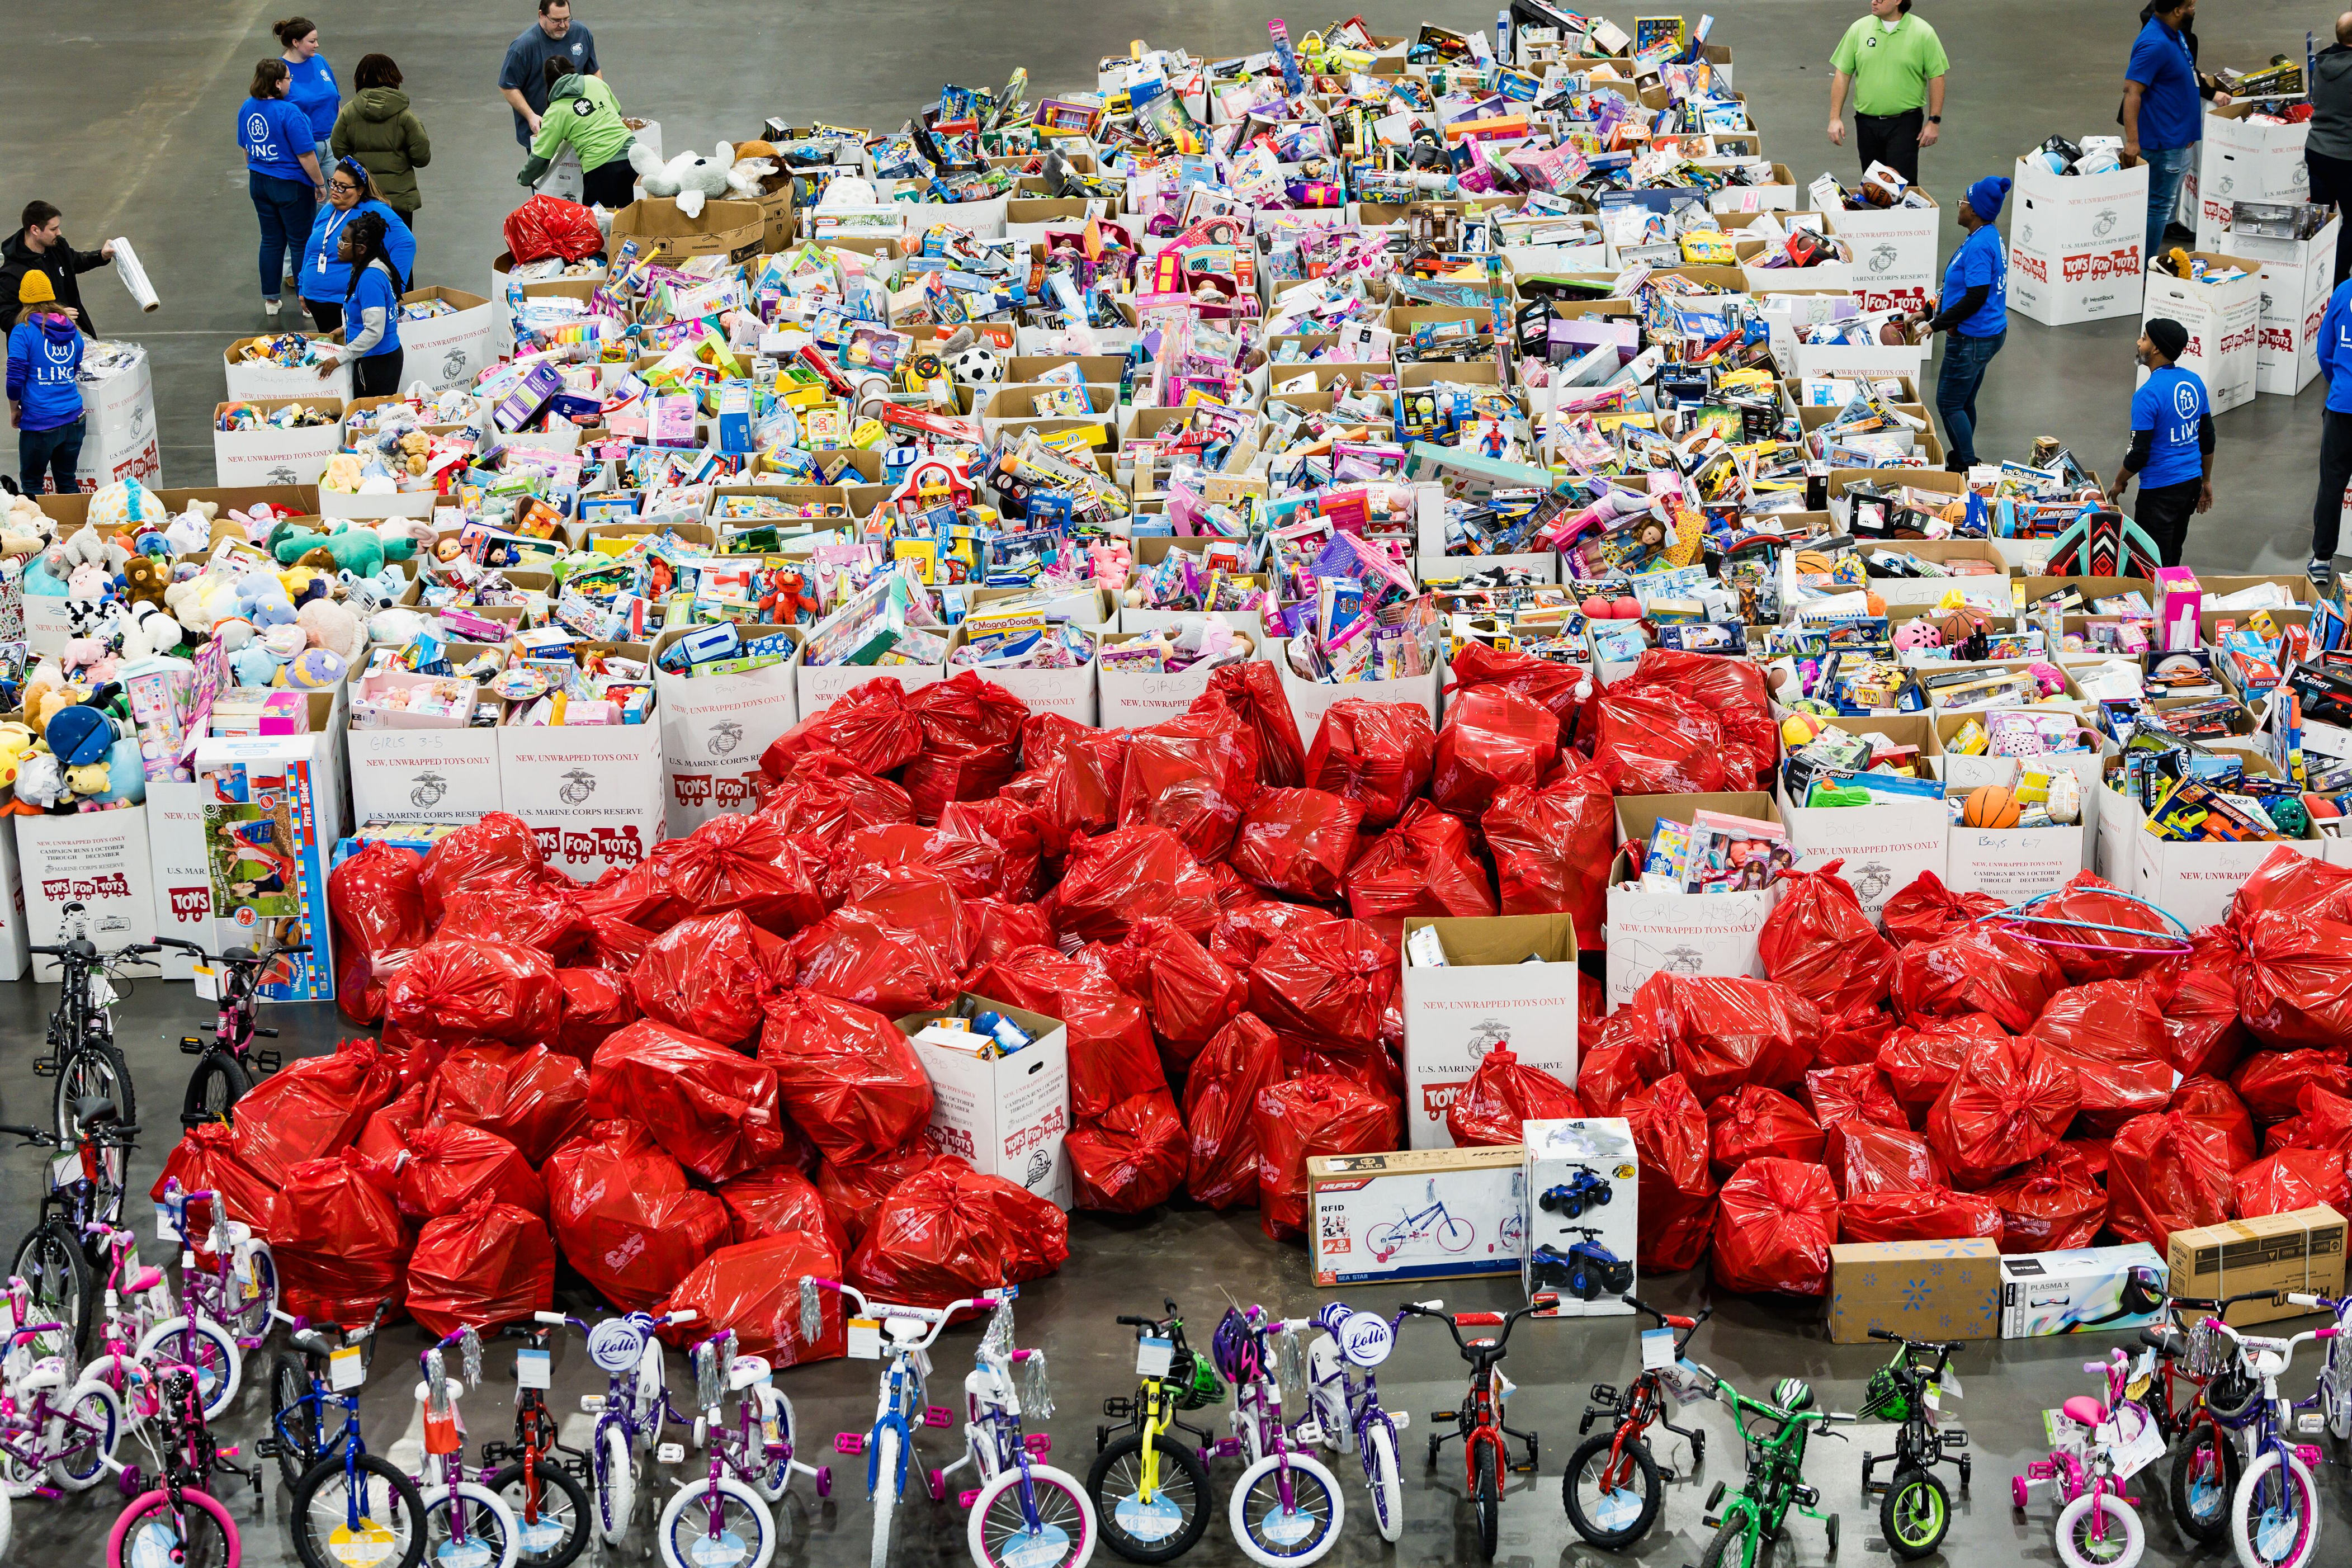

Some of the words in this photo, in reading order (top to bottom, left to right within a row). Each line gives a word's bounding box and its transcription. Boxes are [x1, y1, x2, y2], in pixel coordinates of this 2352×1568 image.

[1621, 126, 1649, 136] NERF
[2084, 195, 2117, 205] UNWRAPPED
[2118, 192, 2131, 200] TOYS
[2118, 234, 2141, 243] RESERVE
[818, 253, 828, 263] 100
[2065, 258, 2089, 272] TOYS
[2091, 257, 2109, 271] FOR
[2114, 254, 2138, 270] TOTS
[1869, 297, 1888, 309] FOR
[1895, 297, 1922, 310] TOTS
[2090, 294, 2114, 303] WestRock
[411, 343, 426, 352] NEW,
[428, 335, 462, 348] UNWRAPPED
[464, 330, 477, 340] TOYS
[478, 326, 491, 336] ONLY
[2270, 336, 2290, 346] TOTS
[37, 366, 74, 380] LINC
[134, 461, 144, 475] FOR
[146, 451, 157, 467] TOTS
[228, 455, 246, 464] NEW,
[248, 453, 291, 462] UNWRAPPED
[2002, 467, 2038, 481] TROUBLE
[974, 619, 1006, 629] Magna
[1007, 616, 1043, 627] Doodle
[1349, 643, 1369, 665] TROUBLE
[1028, 677, 1061, 696] 3-5
[1142, 678, 1186, 694] GIRLS
[671, 703, 688, 715] NEW,
[690, 703, 740, 714] UNWRAPPED
[742, 698, 763, 708] TOYS
[764, 694, 786, 704] ONLY
[1121, 699, 1141, 707] NEW,
[371, 736, 405, 750] GIRLS
[419, 736, 443, 748] 3-5
[669, 757, 683, 766] U.S.
[720, 756, 749, 766] CORPS
[676, 779, 710, 796] TOYS
[717, 782, 743, 797] FOR
[164, 812, 185, 820] NEW,
[303, 805, 312, 828] First
[1807, 848, 1829, 856] NEW,
[1832, 845, 1888, 855] UNWRAPPED
[1891, 843, 1912, 852] TOYS
[1915, 840, 1939, 850] ONLY
[1979, 836, 2008, 852] Boys
[2022, 838, 2041, 848] 6-7
[45, 882, 69, 894] TOYS
[74, 884, 93, 894] FOR
[98, 881, 125, 892] TOTS
[173, 892, 209, 910] TOYS
[1619, 923, 1641, 934] NEW,
[1644, 925, 1702, 934] UNWRAPPED
[1731, 924, 1756, 933] ONLY
[1423, 1002, 1447, 1010] NEW,
[1450, 1000, 1510, 1009] UNWRAPPED
[1512, 999, 1537, 1007] TOYS
[1539, 997, 1566, 1006] ONLY
[961, 1089, 976, 1098] ONLY
[1010, 1099, 1034, 1114] THROUGH
[1038, 1083, 1060, 1099] DECEMBER
[940, 1100, 970, 1114] DECEMBER
[928, 1127, 944, 1141] FOR
[948, 1135, 971, 1152] TOTS
[1007, 1132, 1024, 1151] TOYS
[1028, 1127, 1041, 1141] FOR
[1045, 1116, 1061, 1132] TOTS
[1320, 1181, 1361, 1191] HUFFY
[2030, 1282, 2062, 1291] PLASMA
[1347, 1323, 1387, 1352] Lolli
[594, 1337, 640, 1359] Lolli
